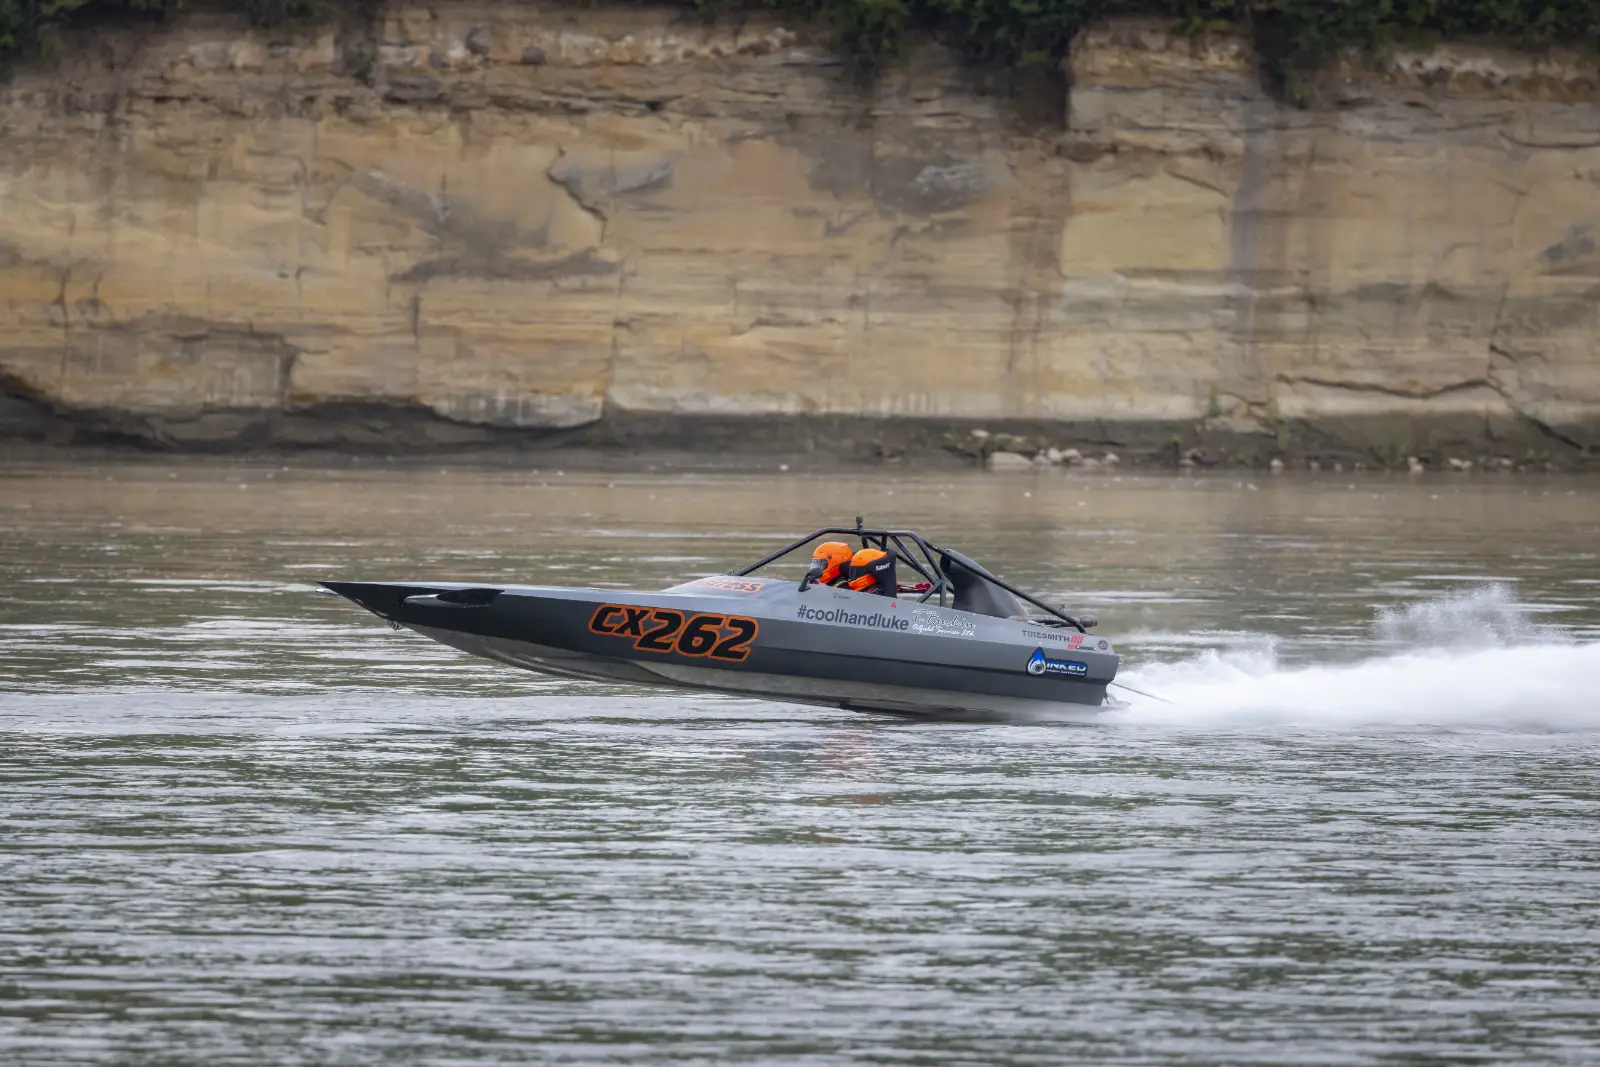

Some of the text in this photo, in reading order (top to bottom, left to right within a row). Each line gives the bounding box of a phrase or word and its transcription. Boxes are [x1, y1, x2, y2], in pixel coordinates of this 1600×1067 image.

[797, 604, 909, 631] #coolhandluke
[588, 603, 759, 662] CX262
[1021, 629, 1070, 643] TIRESMITH
[1046, 662, 1087, 672] INKED
